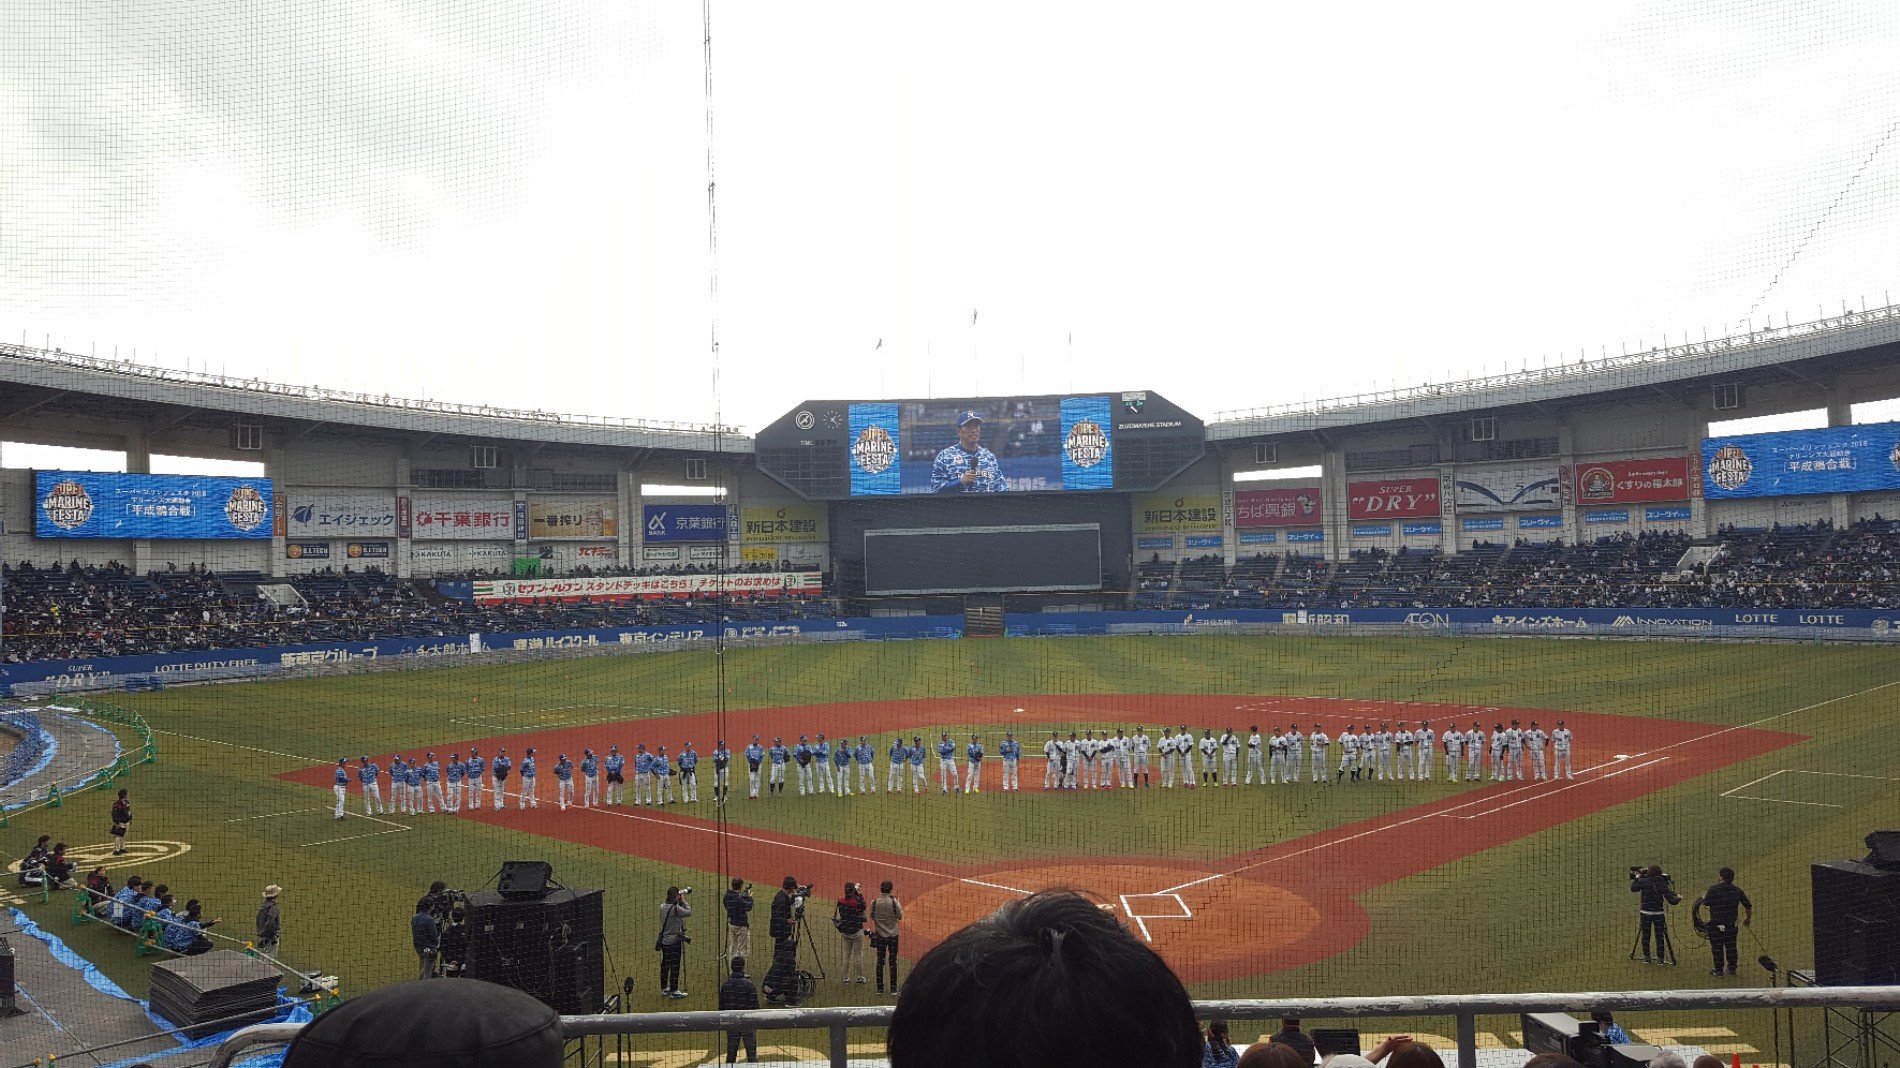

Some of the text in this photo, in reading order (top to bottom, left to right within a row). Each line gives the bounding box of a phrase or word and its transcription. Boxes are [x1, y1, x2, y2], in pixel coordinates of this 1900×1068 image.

[856, 440, 894, 452] MARINE
[1068, 435, 1105, 448] MARINE
[860, 452, 890, 465] FESTA
[1072, 447, 1101, 460] FESTA
[1711, 459, 1749, 472] MARINE
[1716, 471, 1745, 483] FESTA
[1379, 485, 1412, 494] SUPER
[1616, 478, 1683, 491] くすりの福太郎
[48, 495, 90, 510] MARINE
[228, 499, 265, 512] MARINE
[53, 508, 85, 521] FESTA
[1145, 507, 1216, 524] 新日本建設
[1237, 502, 1296, 518] ちば興銀
[232, 511, 260, 523] FESTA
[319, 513, 395, 526] エイジェック
[434, 511, 511, 528] 千葉銀行
[533, 514, 582, 527] 一番搾り
[675, 516, 725, 530] 京葉銀行
[746, 519, 816, 534] 新日本建設
[1636, 616, 1712, 626] INNOVATION
[1735, 613, 1779, 623] LOTTE
[1800, 615, 1844, 625] LOTTE
[619, 629, 704, 644] 東京インテリア
[155, 658, 259, 674] LOTTE DUTY FREE
